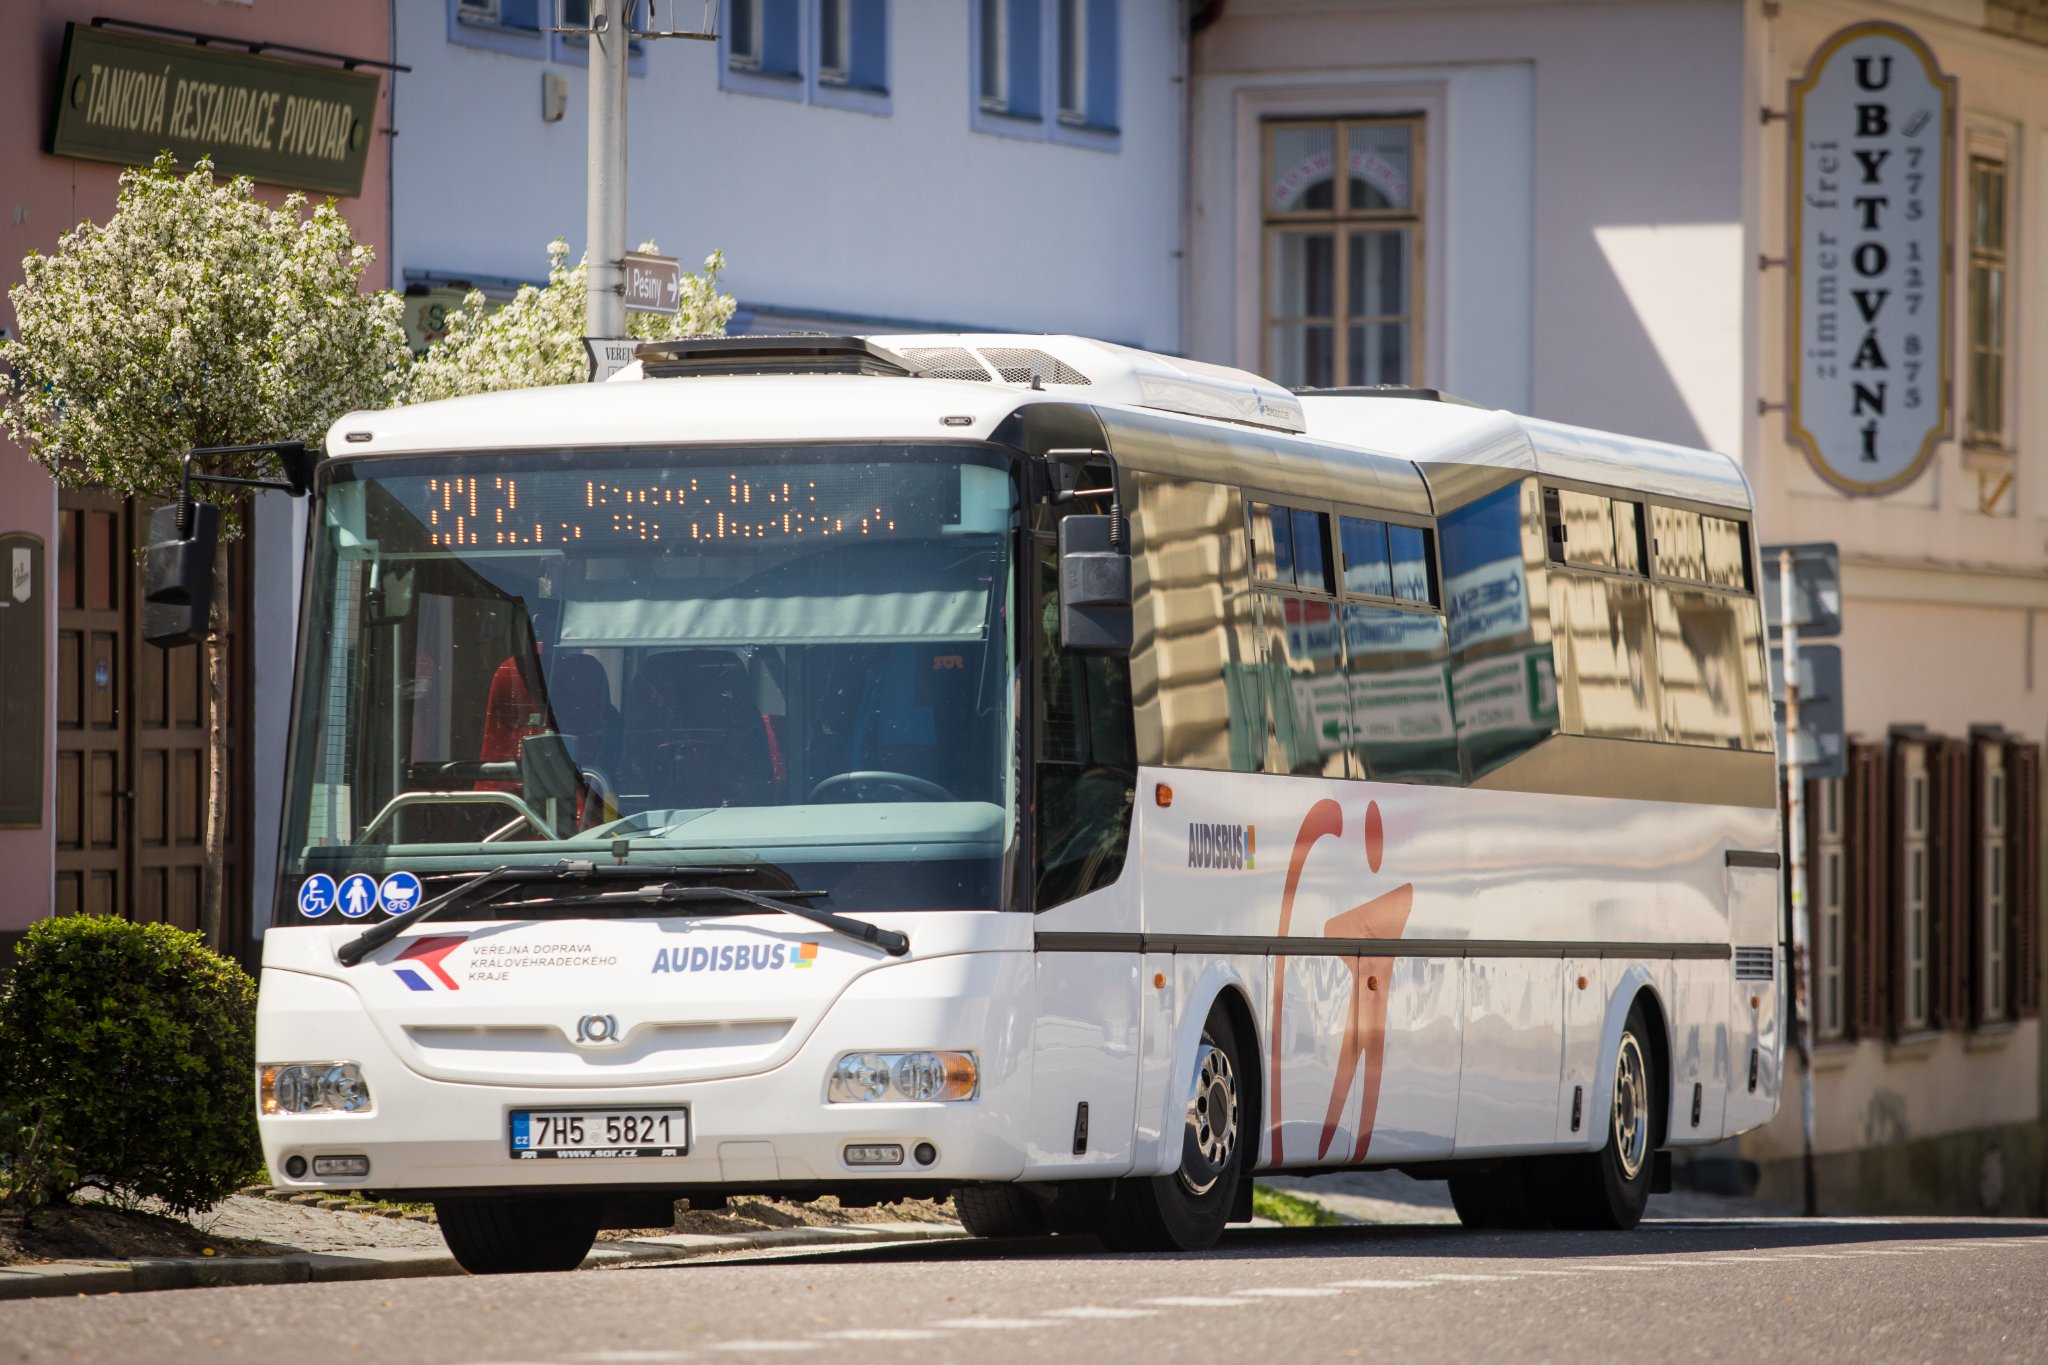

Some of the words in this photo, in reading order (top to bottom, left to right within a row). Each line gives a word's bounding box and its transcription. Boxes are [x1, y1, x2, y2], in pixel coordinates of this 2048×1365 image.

[86, 64, 170, 136] TANKOVÁ
[169, 79, 280, 150] RESTAURACE
[279, 95, 352, 161] PIVOVAR
[1807, 142, 1839, 209] frei
[1905, 147, 1924, 221] 775
[1851, 56, 1893, 462] UBYTOVÁNÍ
[1809, 231, 1838, 378] zimmer
[1188, 823, 1243, 870] AUDISBUS
[470, 956, 617, 968] KRÁLOVÉHRADECKÉHO
[473, 944, 528, 955] VEŘEJNÁ
[533, 944, 592, 954] DOPRAVA
[651, 943, 786, 974] AUDISBUS
[468, 971, 510, 981] KRAJE
[515, 1136, 529, 1145] CZ
[536, 1117, 584, 1145] 7H5
[606, 1115, 670, 1143] 5821
[556, 1149, 638, 1158] www.sor.cz
